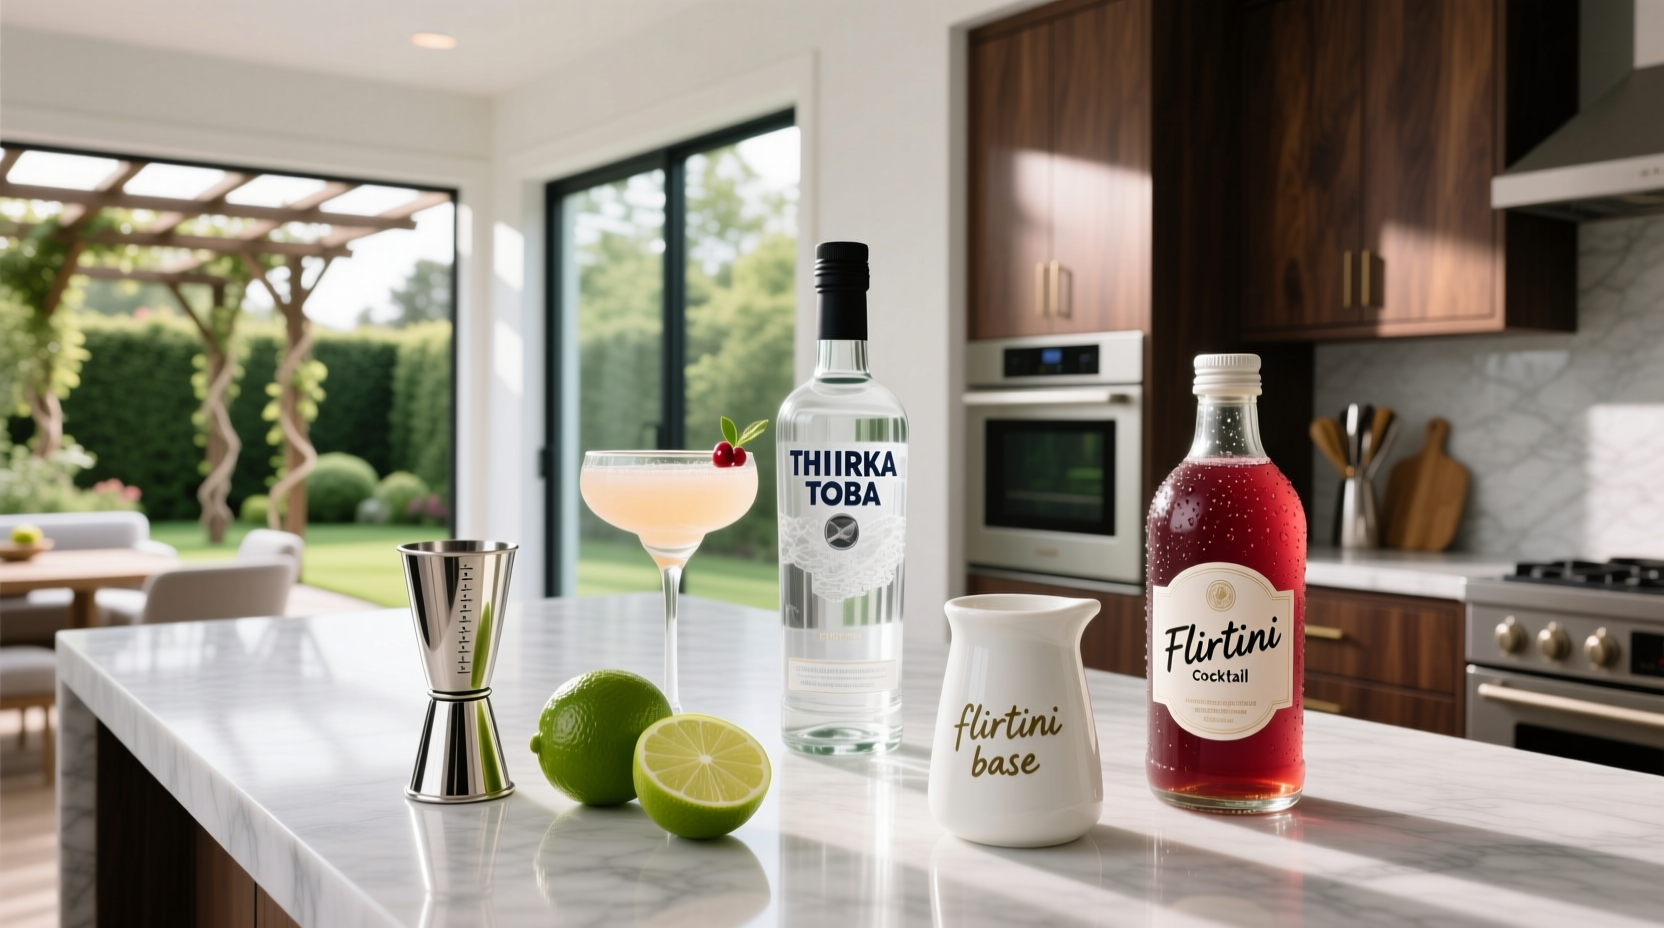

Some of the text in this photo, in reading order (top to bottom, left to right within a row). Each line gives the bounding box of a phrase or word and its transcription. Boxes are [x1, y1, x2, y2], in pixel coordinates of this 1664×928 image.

[789, 450, 897, 477] THIIRKA
[805, 480, 881, 506] TOBA
[1165, 616, 1282, 673] Flirtini
[1192, 668, 1249, 683] Cocktail
[954, 703, 1063, 752] flirtini
[971, 745, 1040, 778] base
